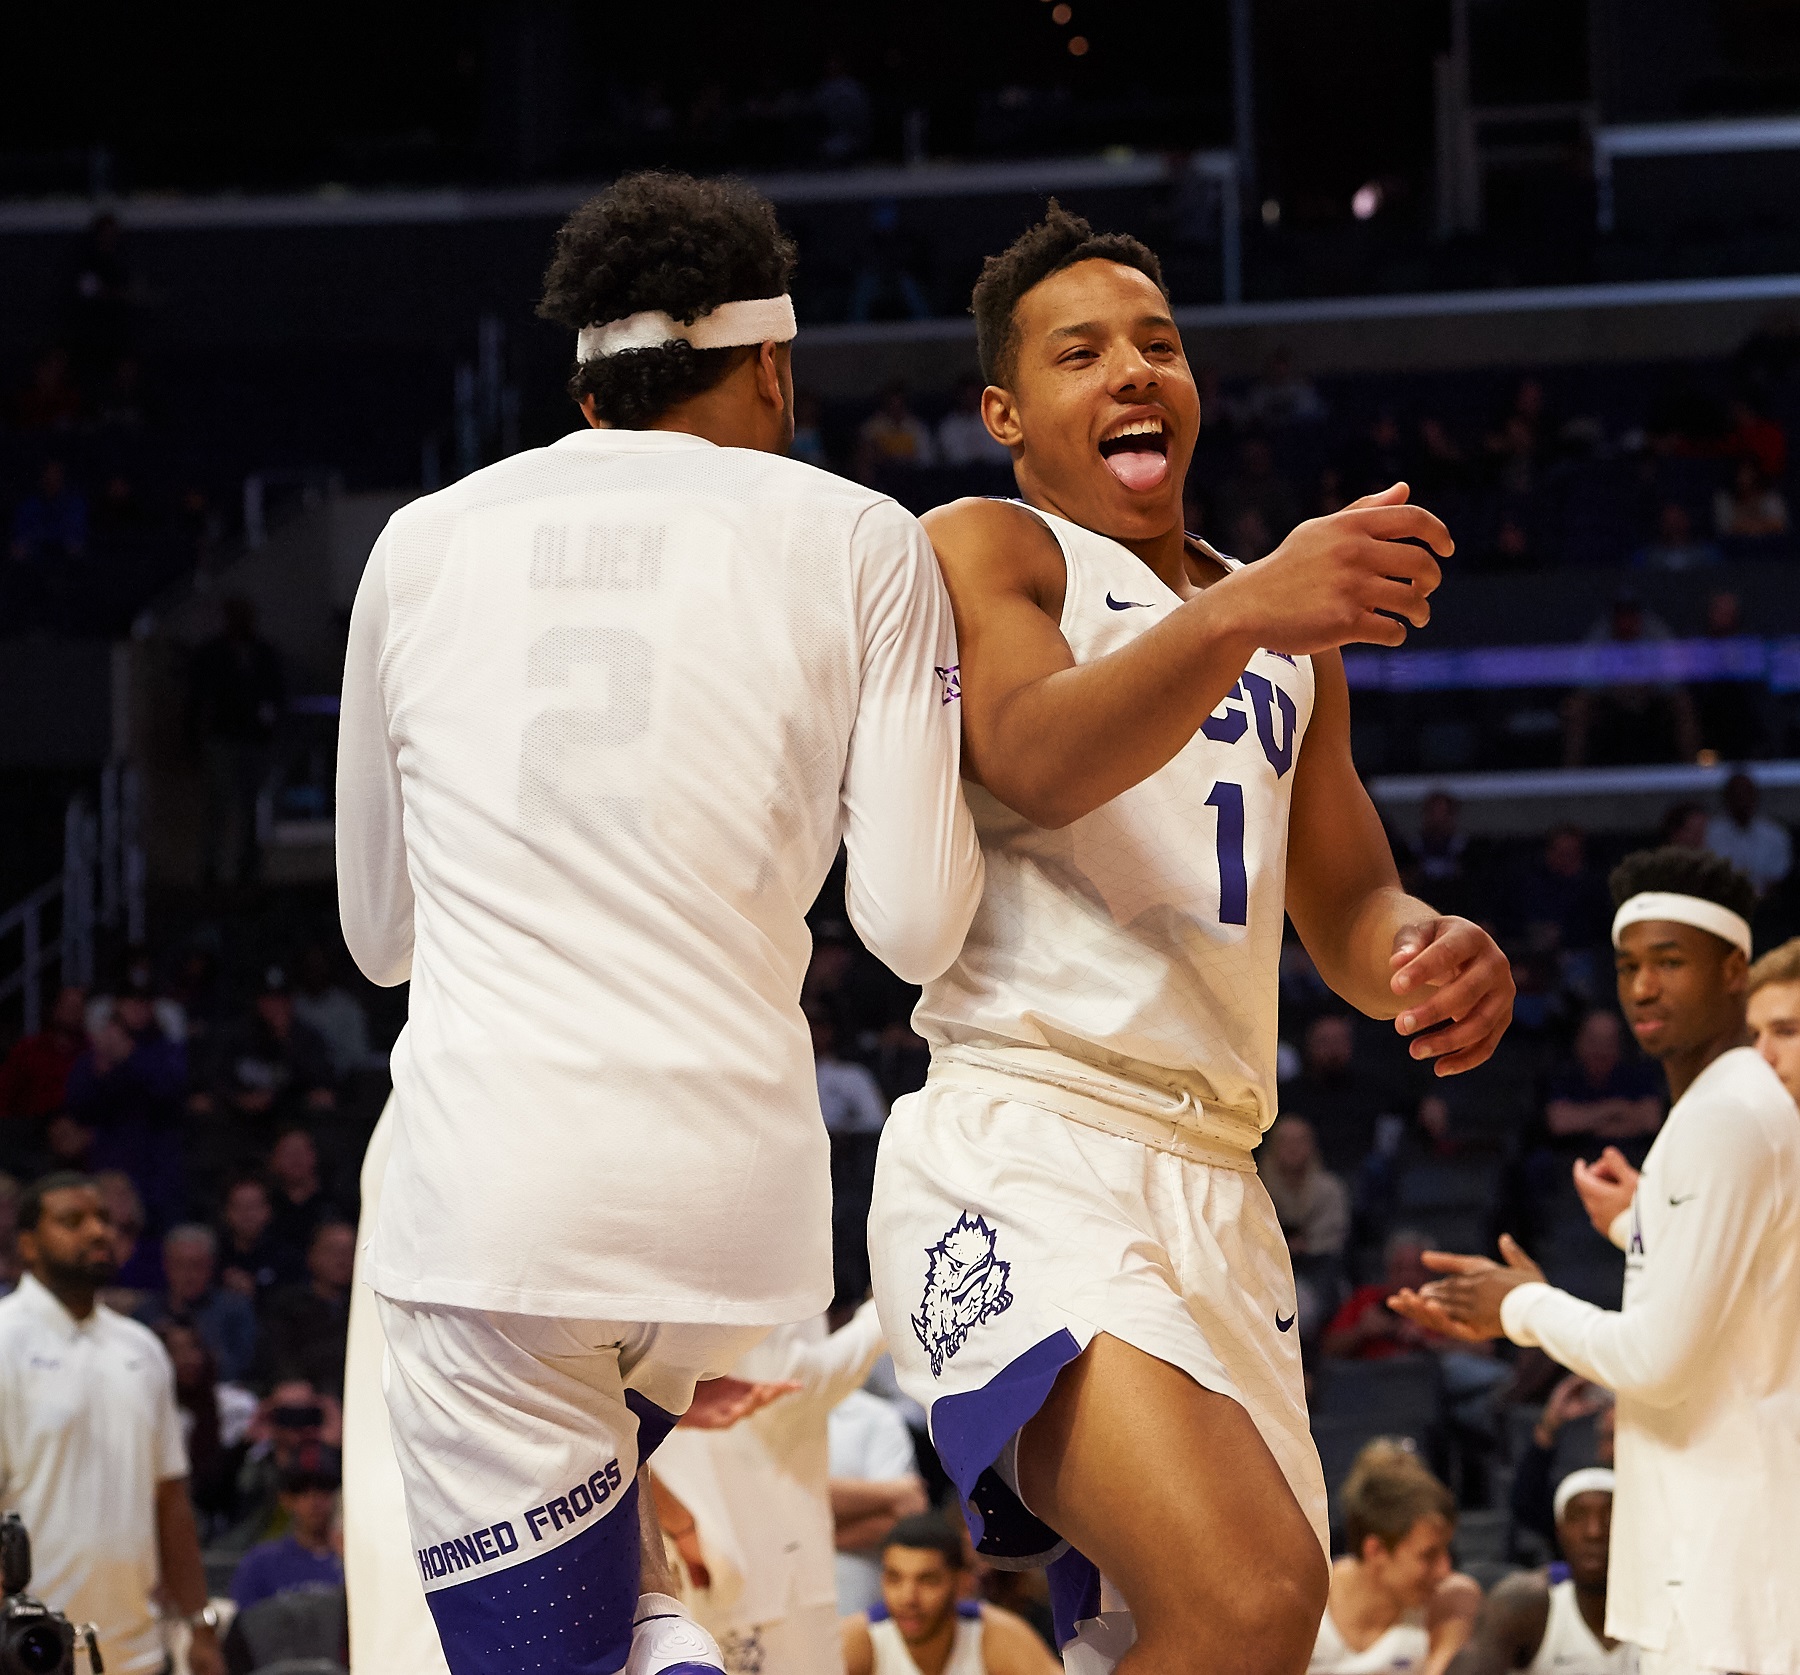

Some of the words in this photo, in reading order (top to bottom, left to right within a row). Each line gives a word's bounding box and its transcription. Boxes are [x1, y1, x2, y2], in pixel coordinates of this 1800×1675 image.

[517, 626, 655, 836] 2
[1200, 670, 1297, 779] CU
[1204, 781, 1247, 926] 1
[418, 1520, 519, 1581] HORNED
[523, 1458, 622, 1542] FROGS
